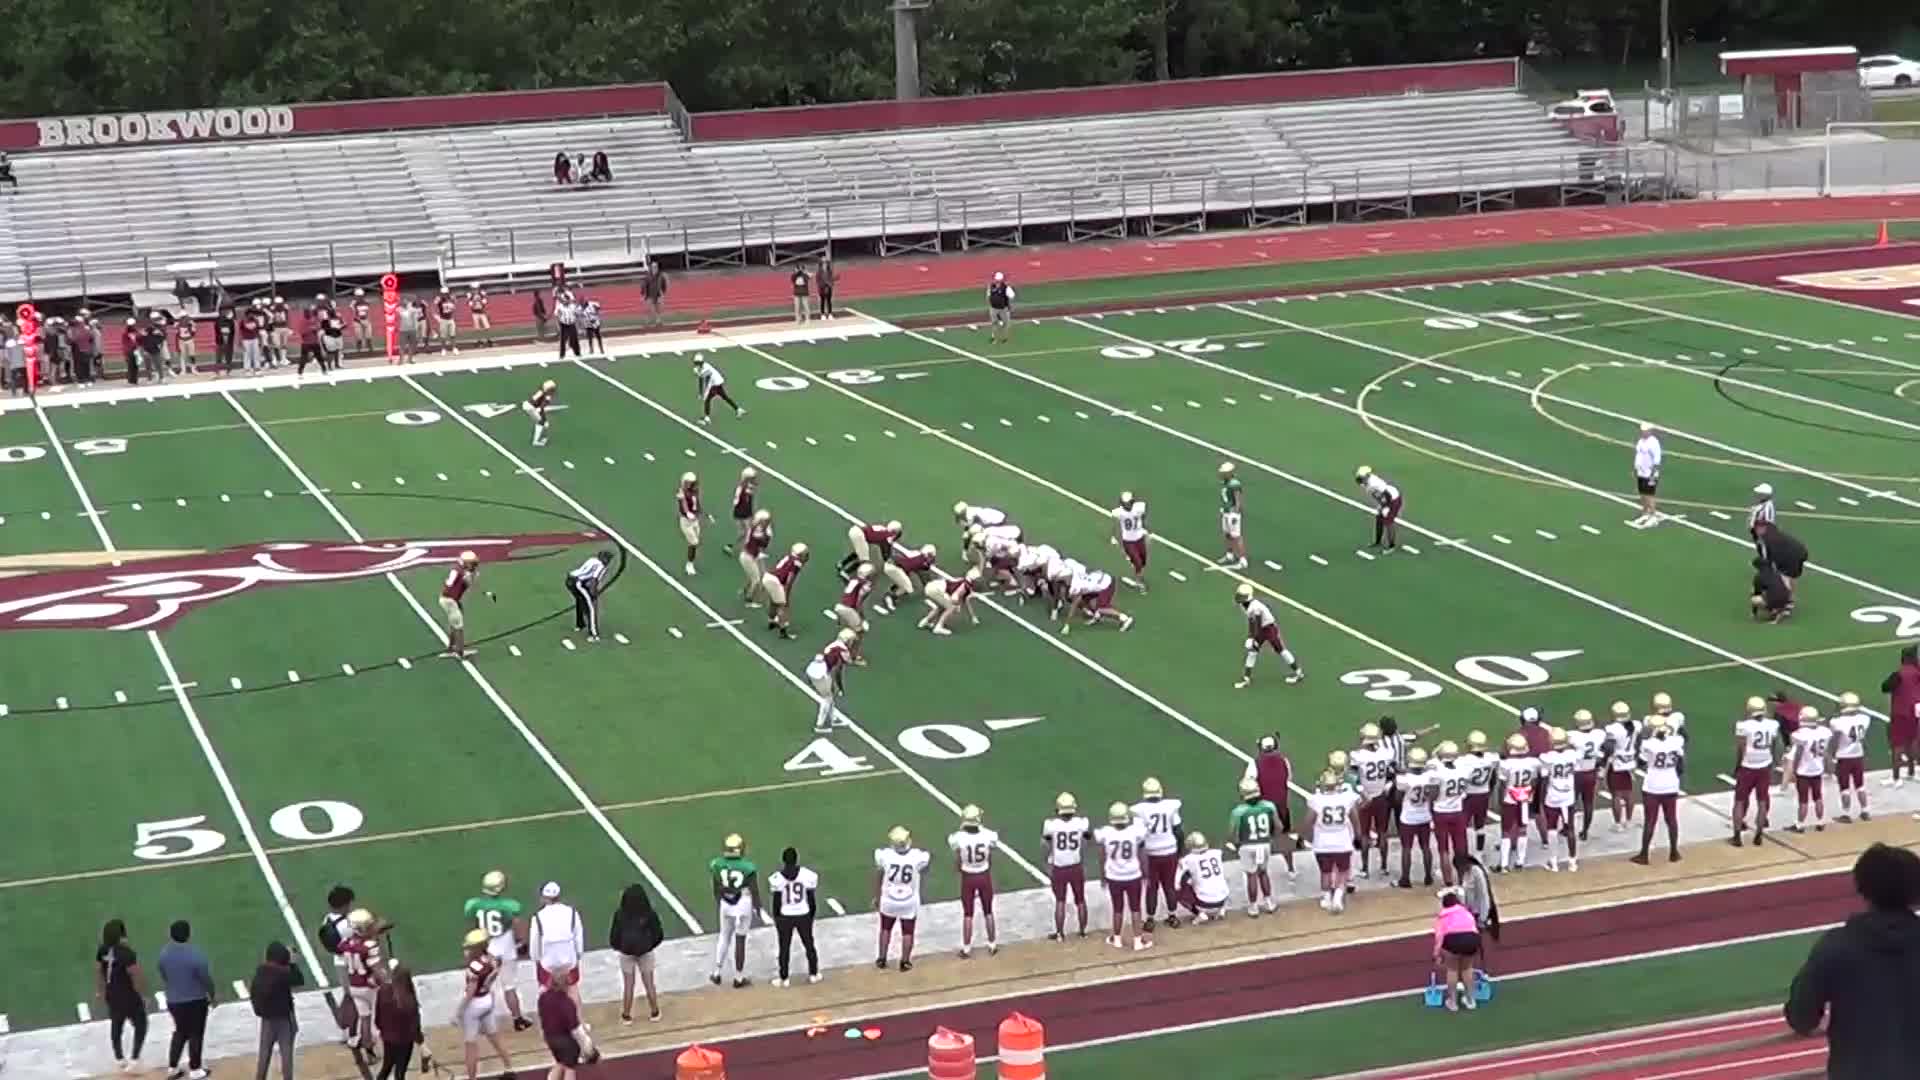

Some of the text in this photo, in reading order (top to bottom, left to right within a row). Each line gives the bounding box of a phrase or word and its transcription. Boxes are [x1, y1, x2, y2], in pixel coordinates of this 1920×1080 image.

[38, 108, 294, 146] BROOKWOOD
[1149, 813, 1168, 834] 71
[1322, 805, 1346, 825] 63
[1247, 812, 1271, 840] 19
[1056, 831, 1079, 851] 85
[1109, 839, 1133, 860] 78
[965, 843, 986, 864] 15
[888, 863, 914, 884] 76
[1199, 856, 1222, 879] 58
[784, 882, 804, 905] 19
[477, 910, 502, 937] 16
